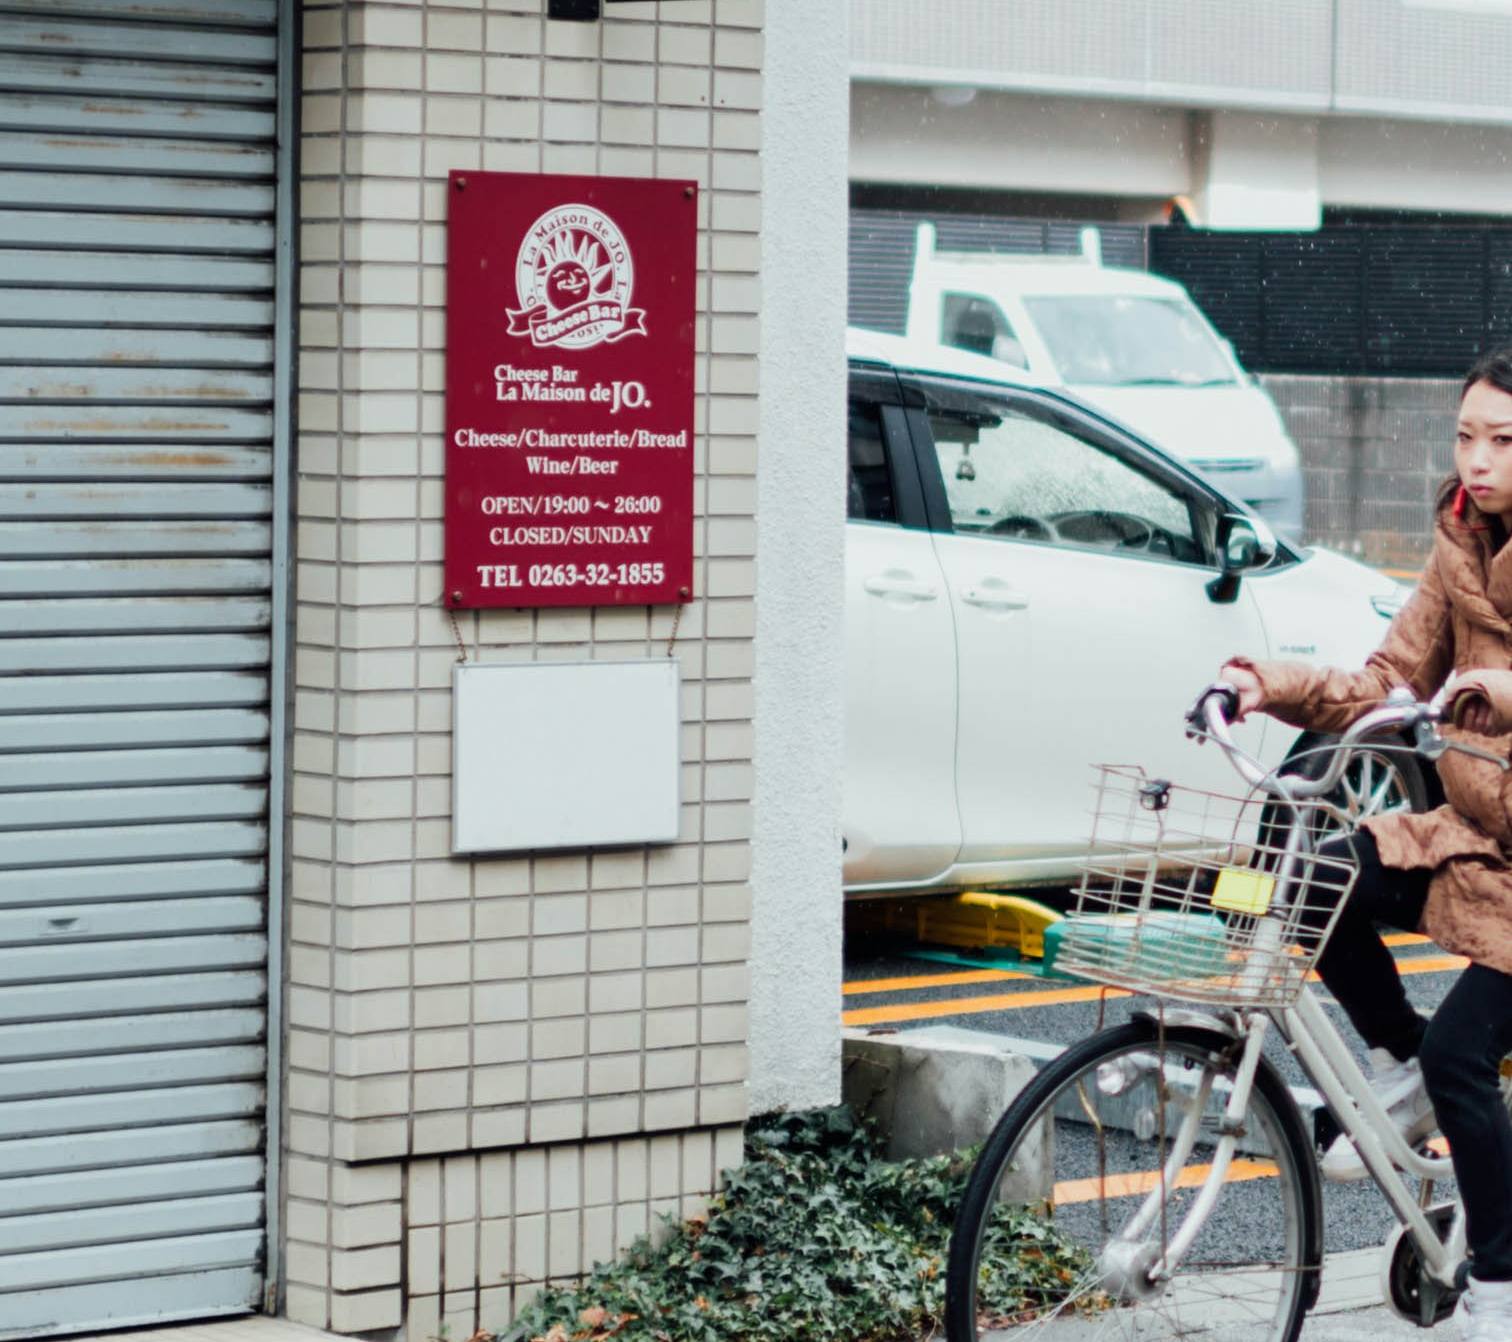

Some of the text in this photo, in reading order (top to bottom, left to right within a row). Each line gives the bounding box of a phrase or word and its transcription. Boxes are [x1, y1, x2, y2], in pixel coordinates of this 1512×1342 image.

[534, 213, 588, 241] Maison
[535, 310, 588, 340] Cheese
[588, 304, 621, 321] Bar
[494, 364, 578, 383] Cheese Bar
[496, 382, 518, 402] La
[521, 382, 586, 403] Maison
[589, 383, 610, 403] de
[454, 427, 688, 449] Cheese/Charcuterie/Bread
[526, 456, 619, 476] Wine/Beer
[481, 495, 590, 515] OPEN/19:00
[614, 494, 661, 515] 26:00
[489, 525, 653, 546] CLOSED/SUNDAY
[477, 562, 665, 588] TEL 0263-32-1855
